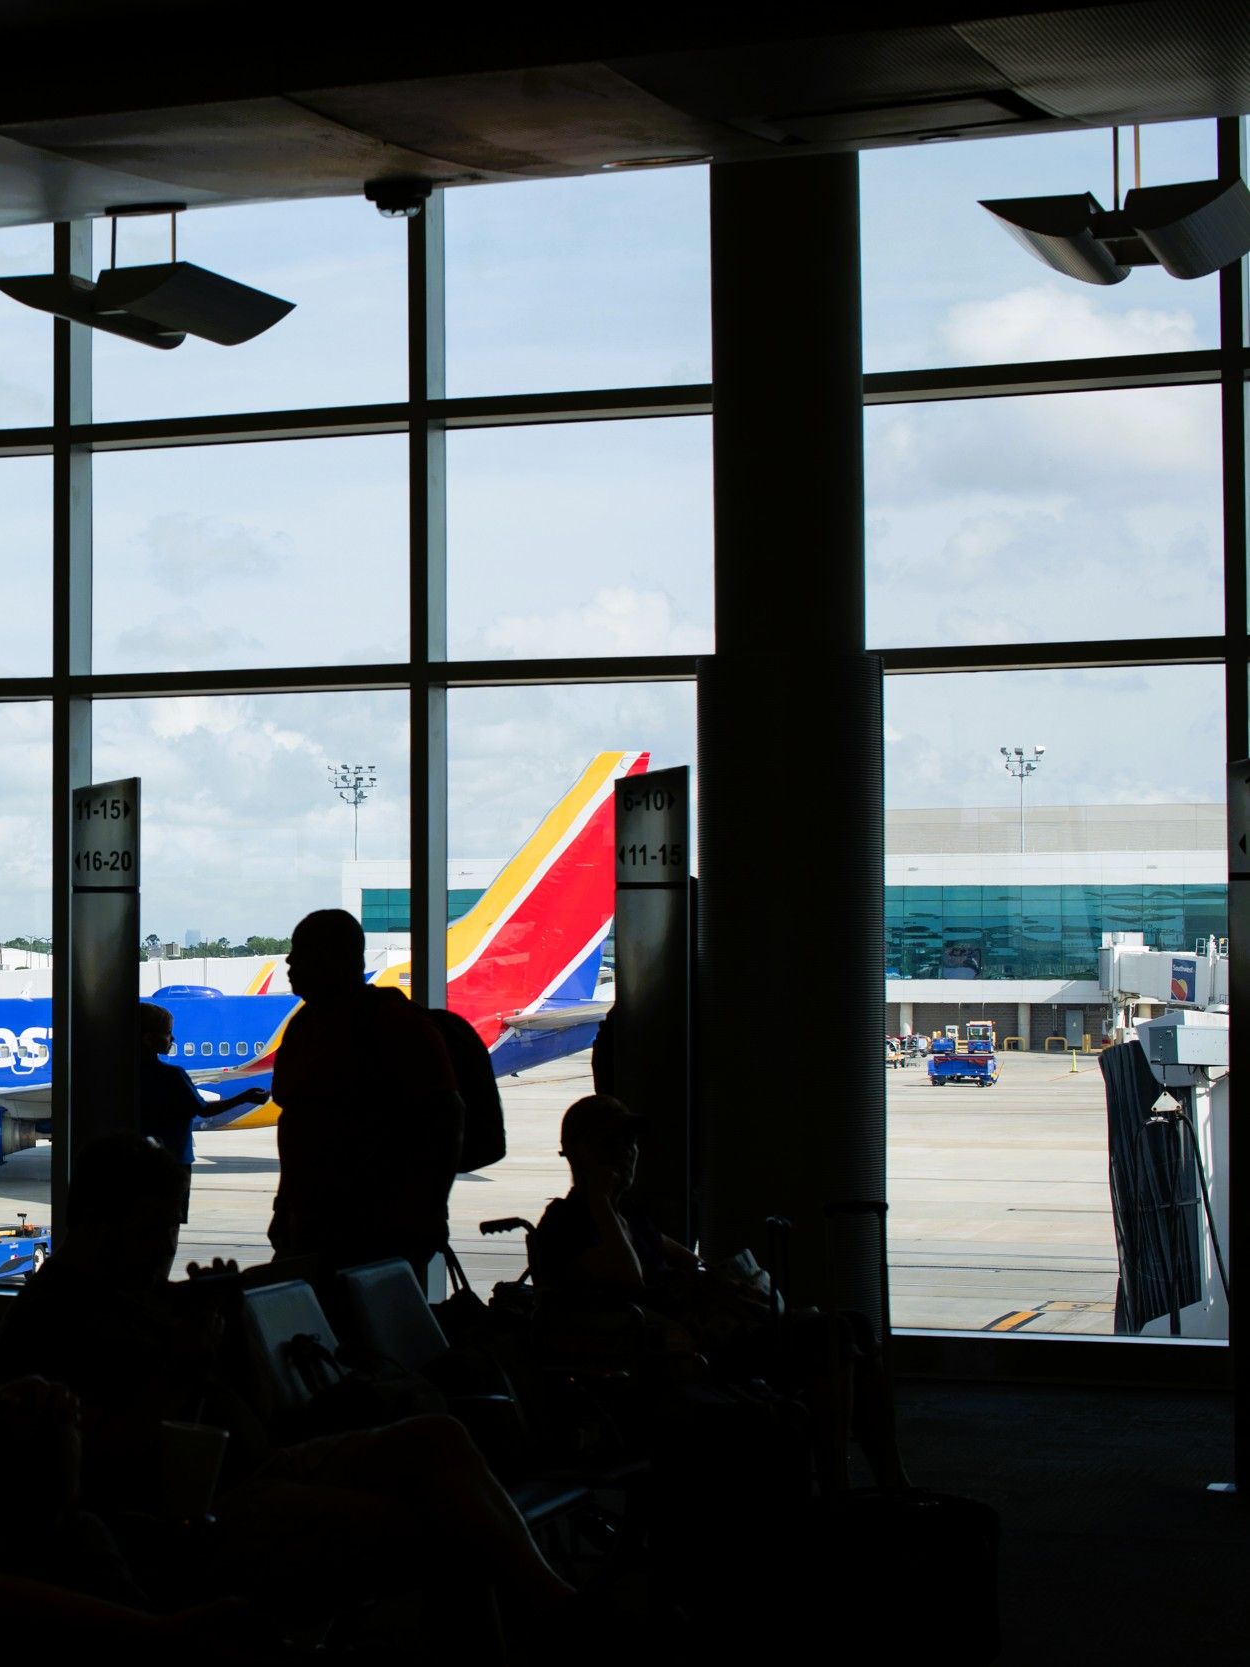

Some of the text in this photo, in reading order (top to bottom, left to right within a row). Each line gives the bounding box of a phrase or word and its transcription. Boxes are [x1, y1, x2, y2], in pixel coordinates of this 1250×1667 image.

[76, 799, 121, 820] 11-15
[623, 789, 665, 811] 6-10
[83, 850, 132, 871] 16-20
[628, 843, 682, 866] 11-15
